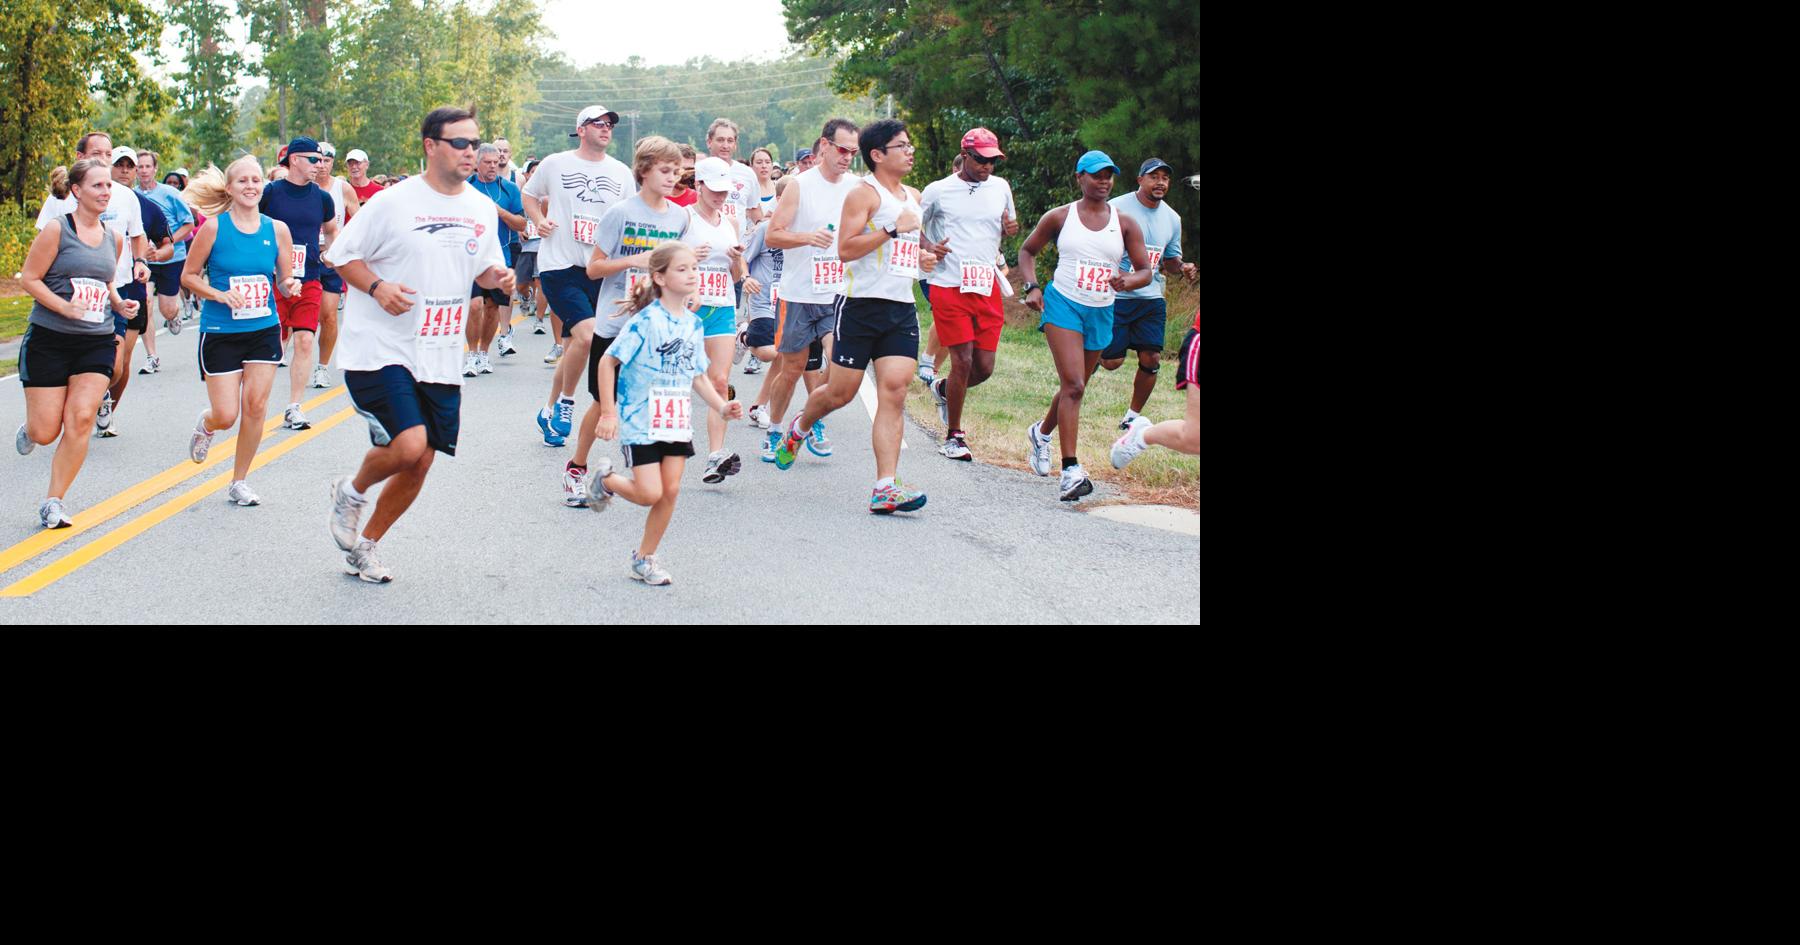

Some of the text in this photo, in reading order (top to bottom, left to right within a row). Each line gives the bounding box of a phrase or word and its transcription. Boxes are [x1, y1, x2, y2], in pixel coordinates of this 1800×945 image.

[815, 262, 844, 277] 1594
[963, 266, 992, 280] 1026
[1079, 266, 1112, 284] 1427
[700, 272, 728, 289] 1480
[424, 306, 463, 327] 1414
